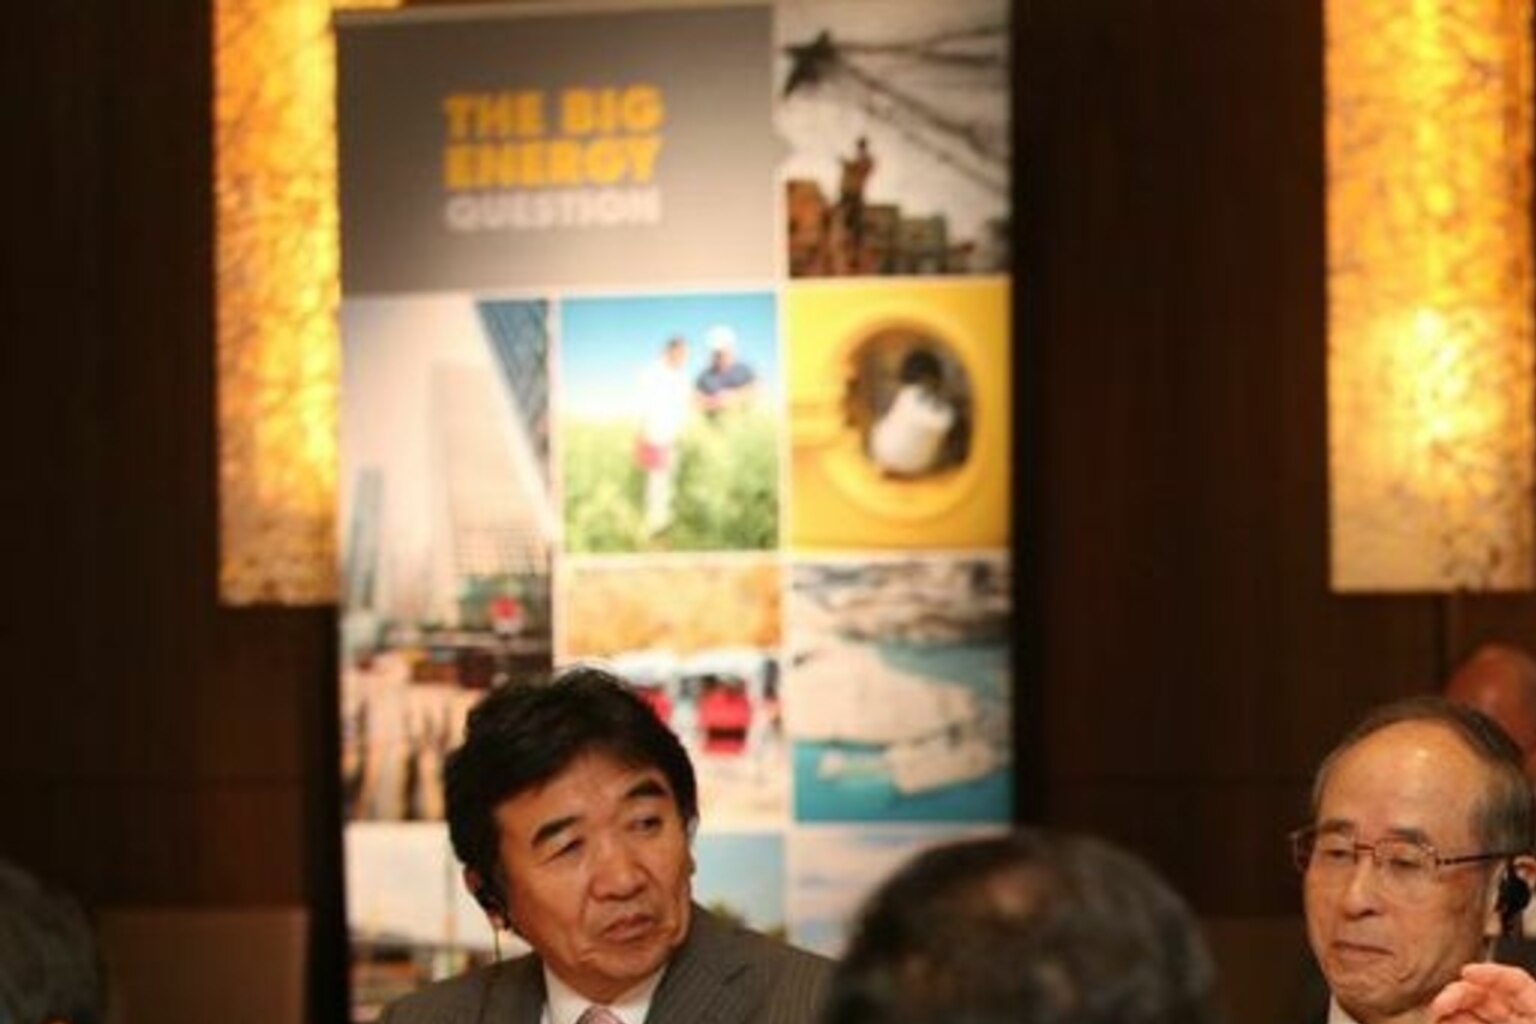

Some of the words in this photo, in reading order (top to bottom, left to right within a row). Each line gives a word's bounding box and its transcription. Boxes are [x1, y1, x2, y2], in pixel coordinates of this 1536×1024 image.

[445, 92, 542, 138] THE
[561, 84, 663, 133] BIG
[445, 136, 661, 190] ENERGY
[447, 186, 662, 229] QUESTION
